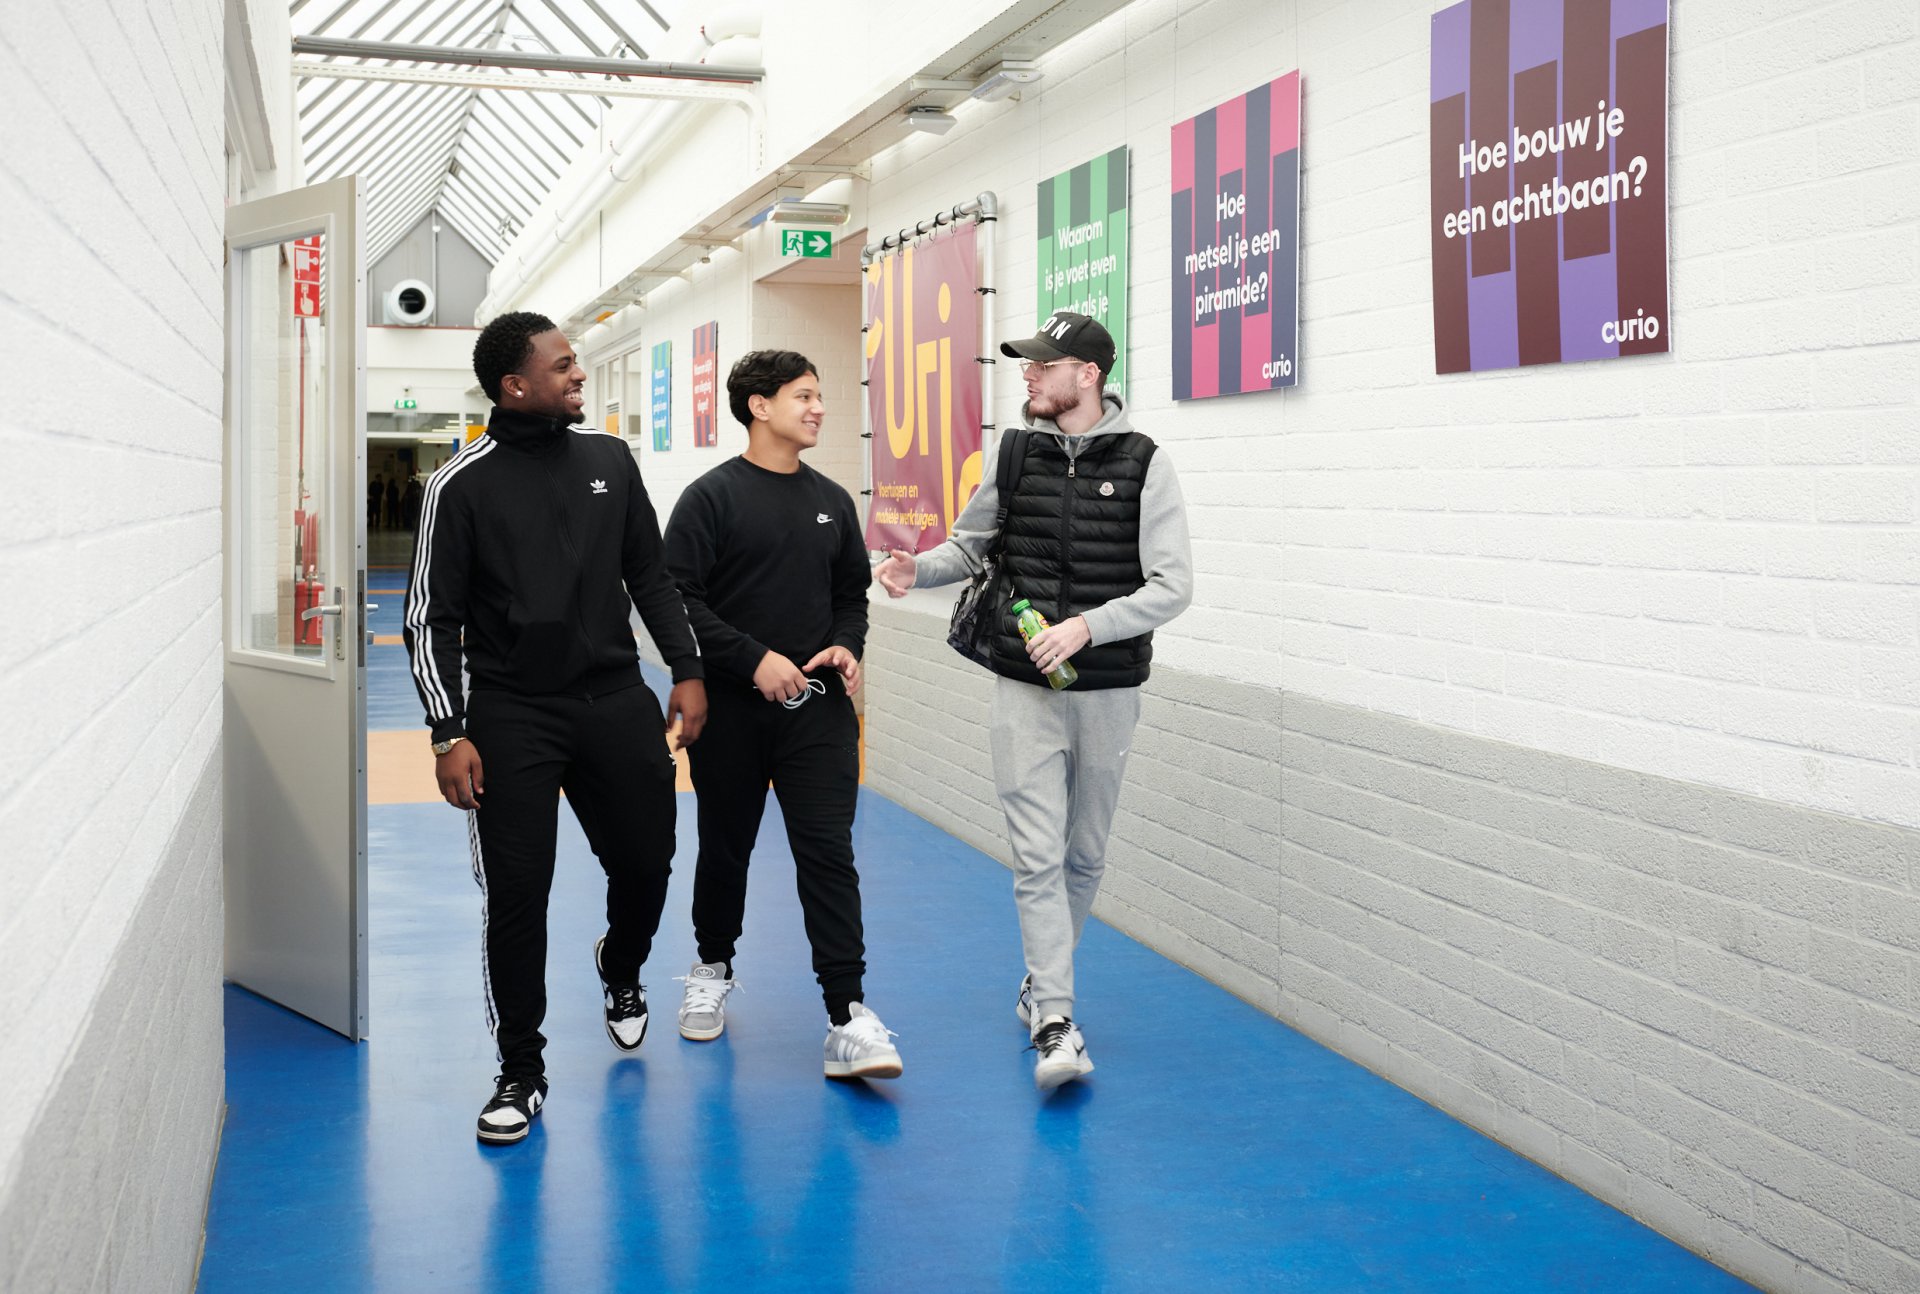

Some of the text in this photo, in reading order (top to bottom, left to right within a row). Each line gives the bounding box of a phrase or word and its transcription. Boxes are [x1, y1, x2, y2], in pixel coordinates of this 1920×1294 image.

[1458, 100, 1625, 178] Hoe bouw je
[1216, 191, 1245, 222] Hoe
[1443, 155, 1648, 238] een achtbaan?
[1058, 220, 1103, 251] Waarom
[1185, 228, 1280, 275] metsel je een
[1045, 254, 1117, 294] is je voet even
[1081, 293, 1097, 317] als
[1098, 290, 1108, 320] je
[1195, 271, 1268, 321] piramide?
[1601, 308, 1660, 343] curio
[1262, 353, 1292, 379] curio
[908, 485, 918, 498] en
[899, 508, 938, 531] werktuigen
